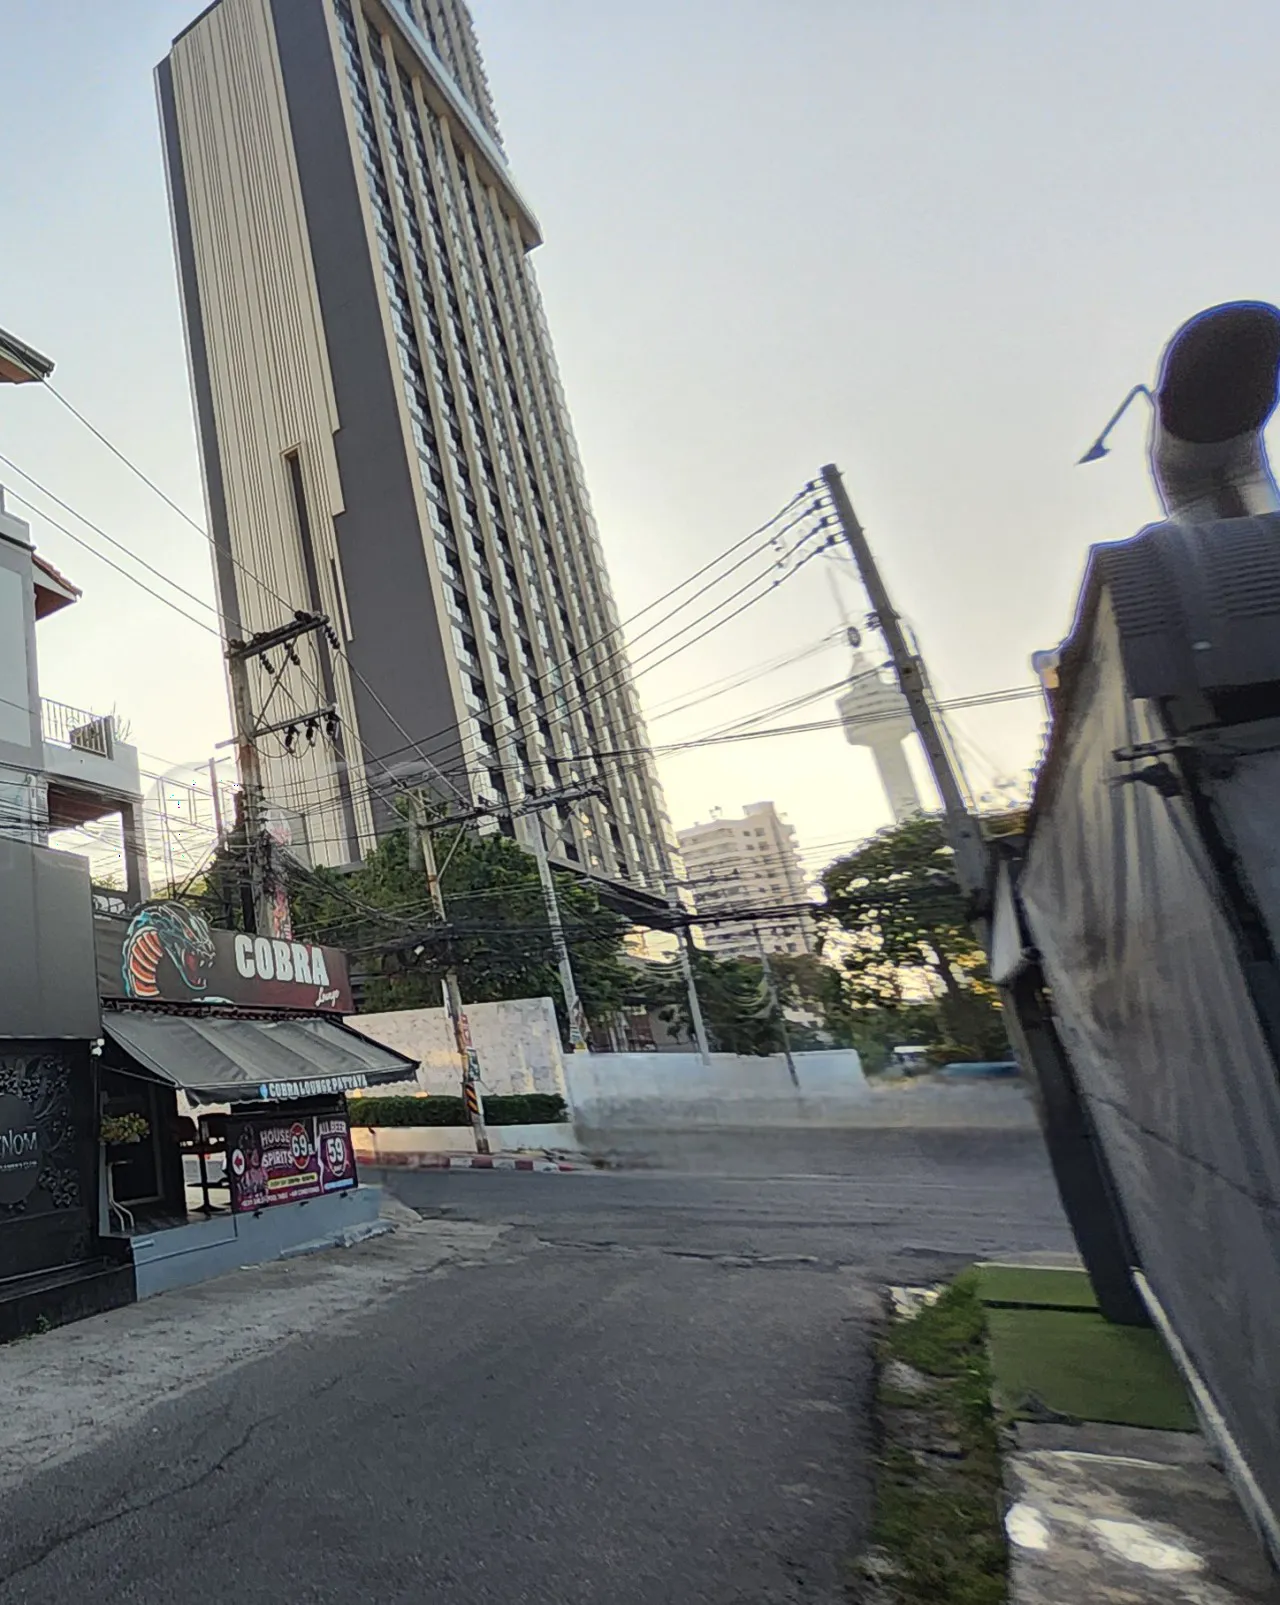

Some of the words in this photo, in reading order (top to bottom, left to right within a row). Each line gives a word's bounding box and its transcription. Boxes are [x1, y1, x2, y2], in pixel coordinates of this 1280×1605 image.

[234, 934, 330, 986] COBRA
[260, 1129, 290, 1148] HOUSE
[261, 1150, 294, 1168] SPIRITS
[326, 1137, 344, 1164] 59
